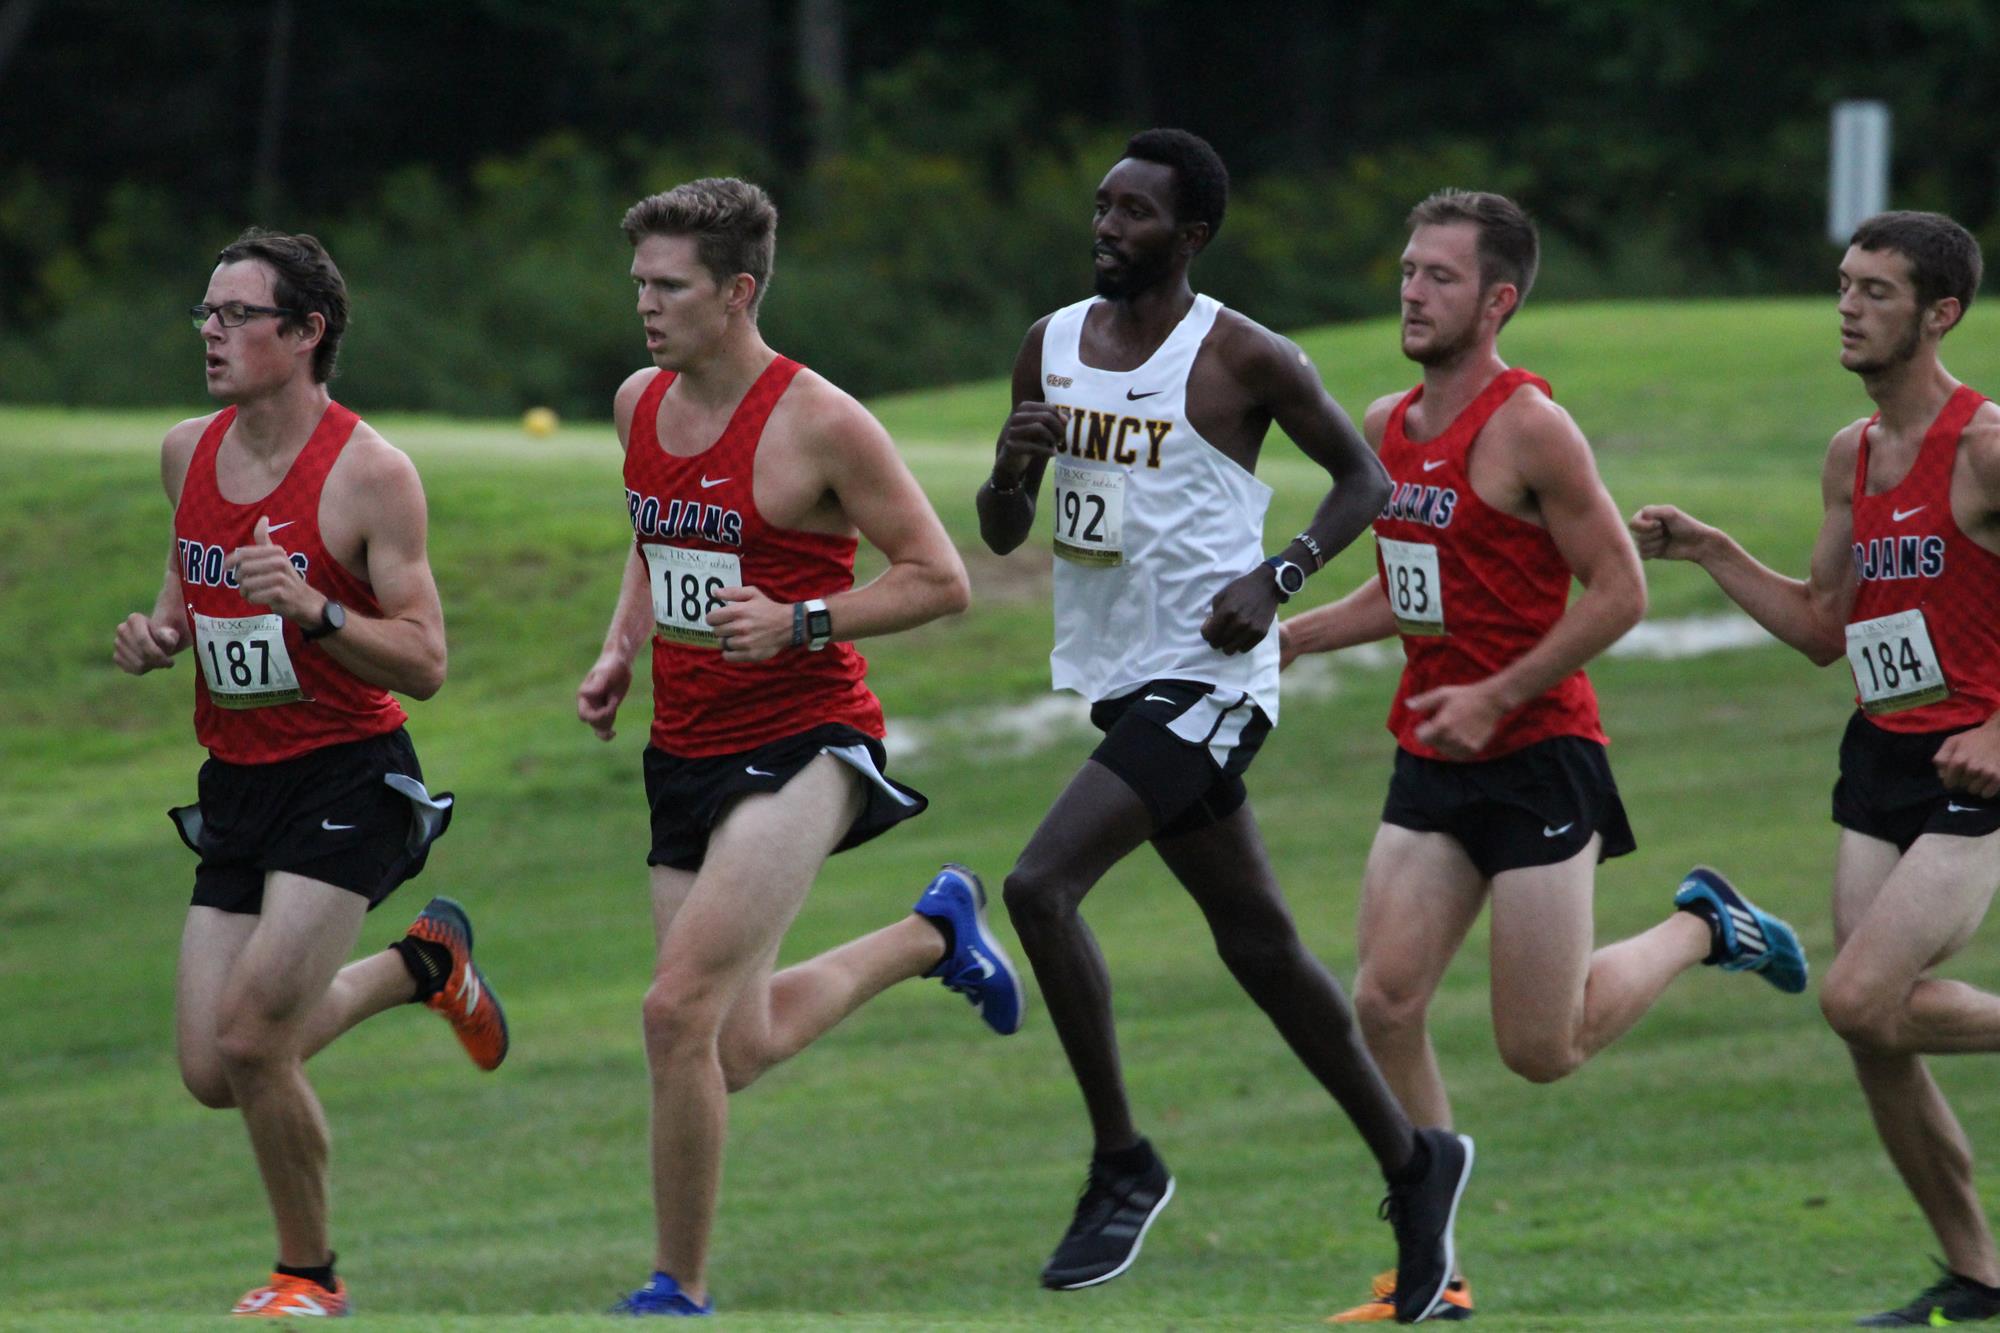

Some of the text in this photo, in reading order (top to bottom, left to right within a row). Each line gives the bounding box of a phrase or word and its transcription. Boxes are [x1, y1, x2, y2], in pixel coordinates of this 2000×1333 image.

[1055, 404, 1173, 469] INCY
[625, 488, 742, 547] ROJANS
[1055, 487, 1106, 543] 192
[1380, 481, 1458, 528] JANS
[1388, 563, 1428, 614] 183
[208, 640, 270, 687] 187
[1862, 637, 1922, 692] 184
